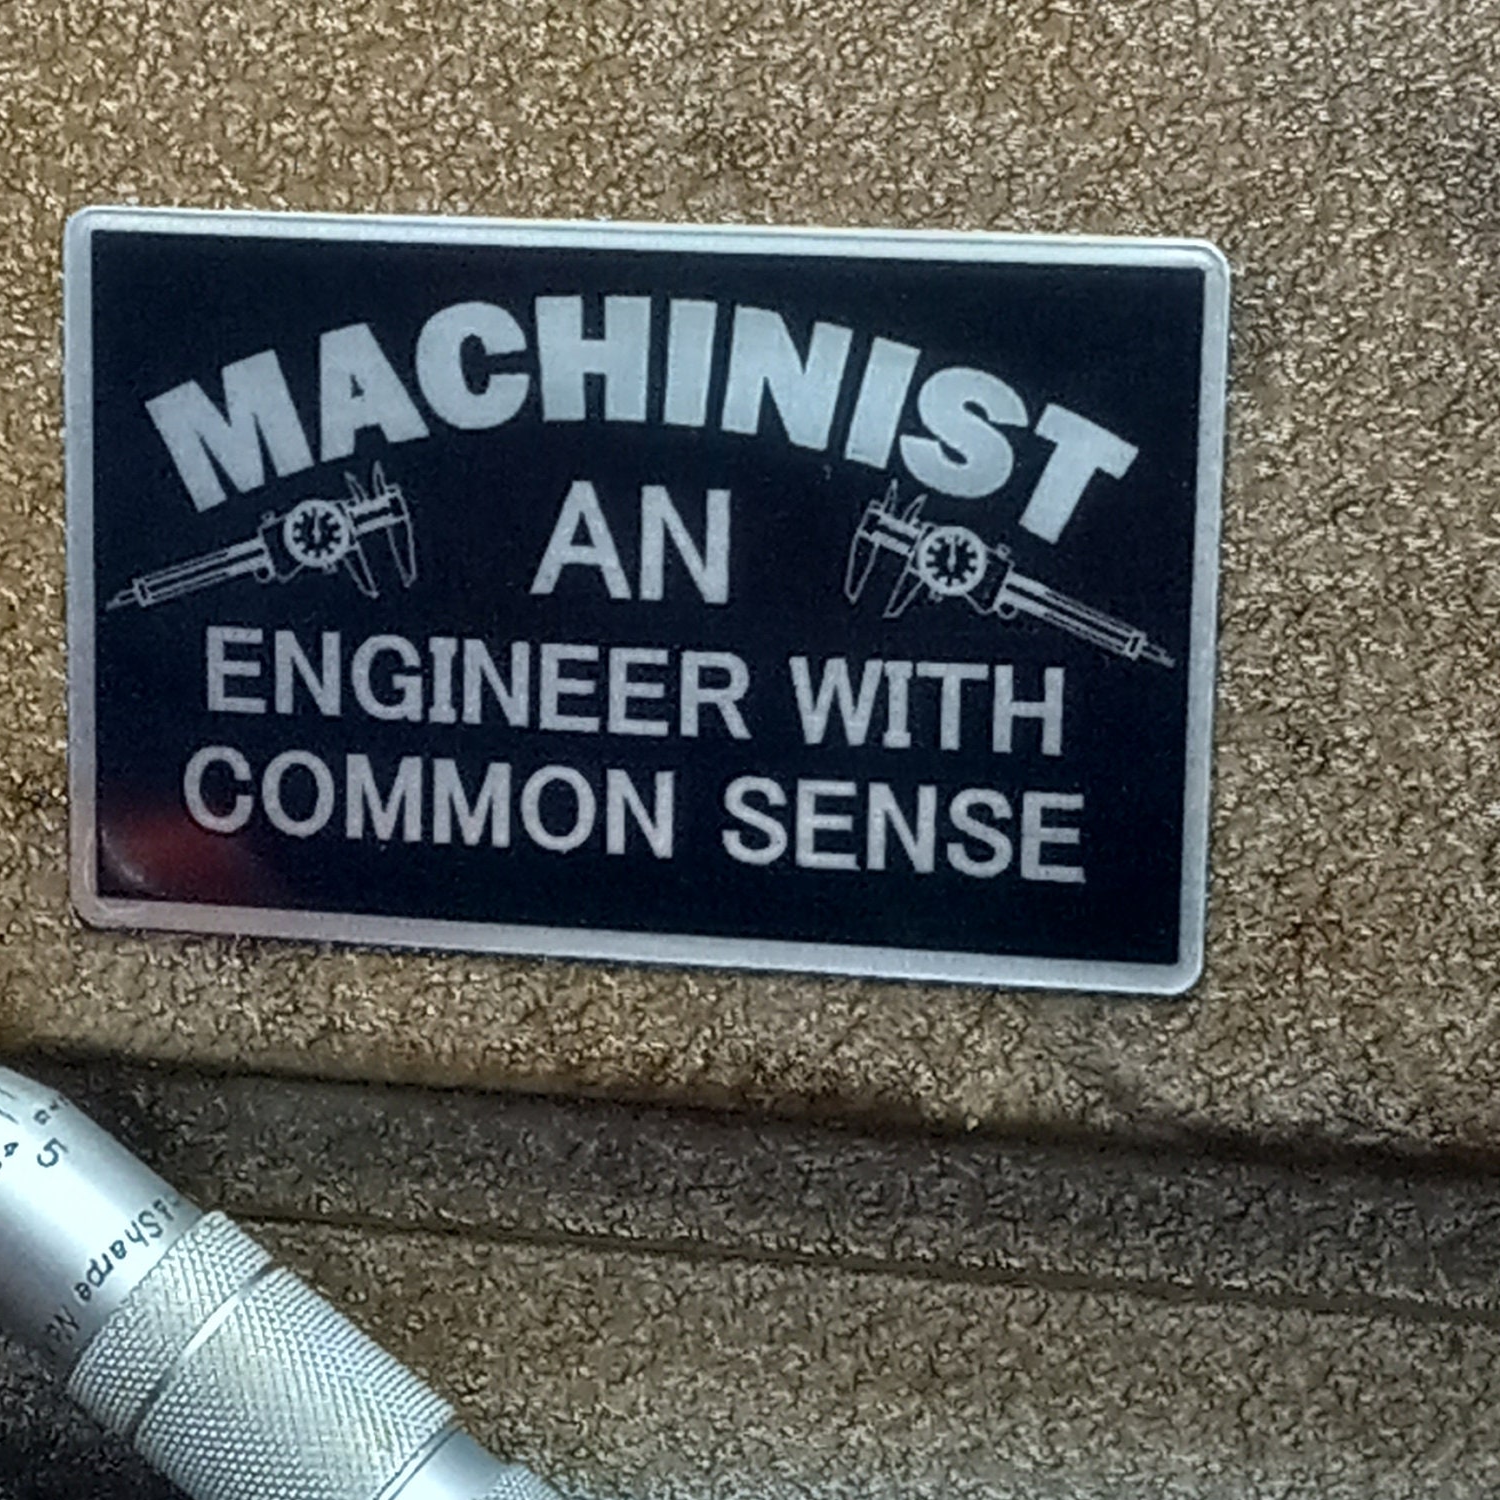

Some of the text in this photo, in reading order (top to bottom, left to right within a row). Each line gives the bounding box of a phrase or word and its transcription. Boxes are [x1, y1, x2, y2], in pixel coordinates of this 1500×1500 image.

[144, 294, 1139, 544] MACHINIST
[529, 480, 731, 604] AN
[206, 625, 1065, 756] ENGINEER WITH
[183, 745, 1086, 884] COMMON SENSE
[36, 1137, 69, 1168] 5
